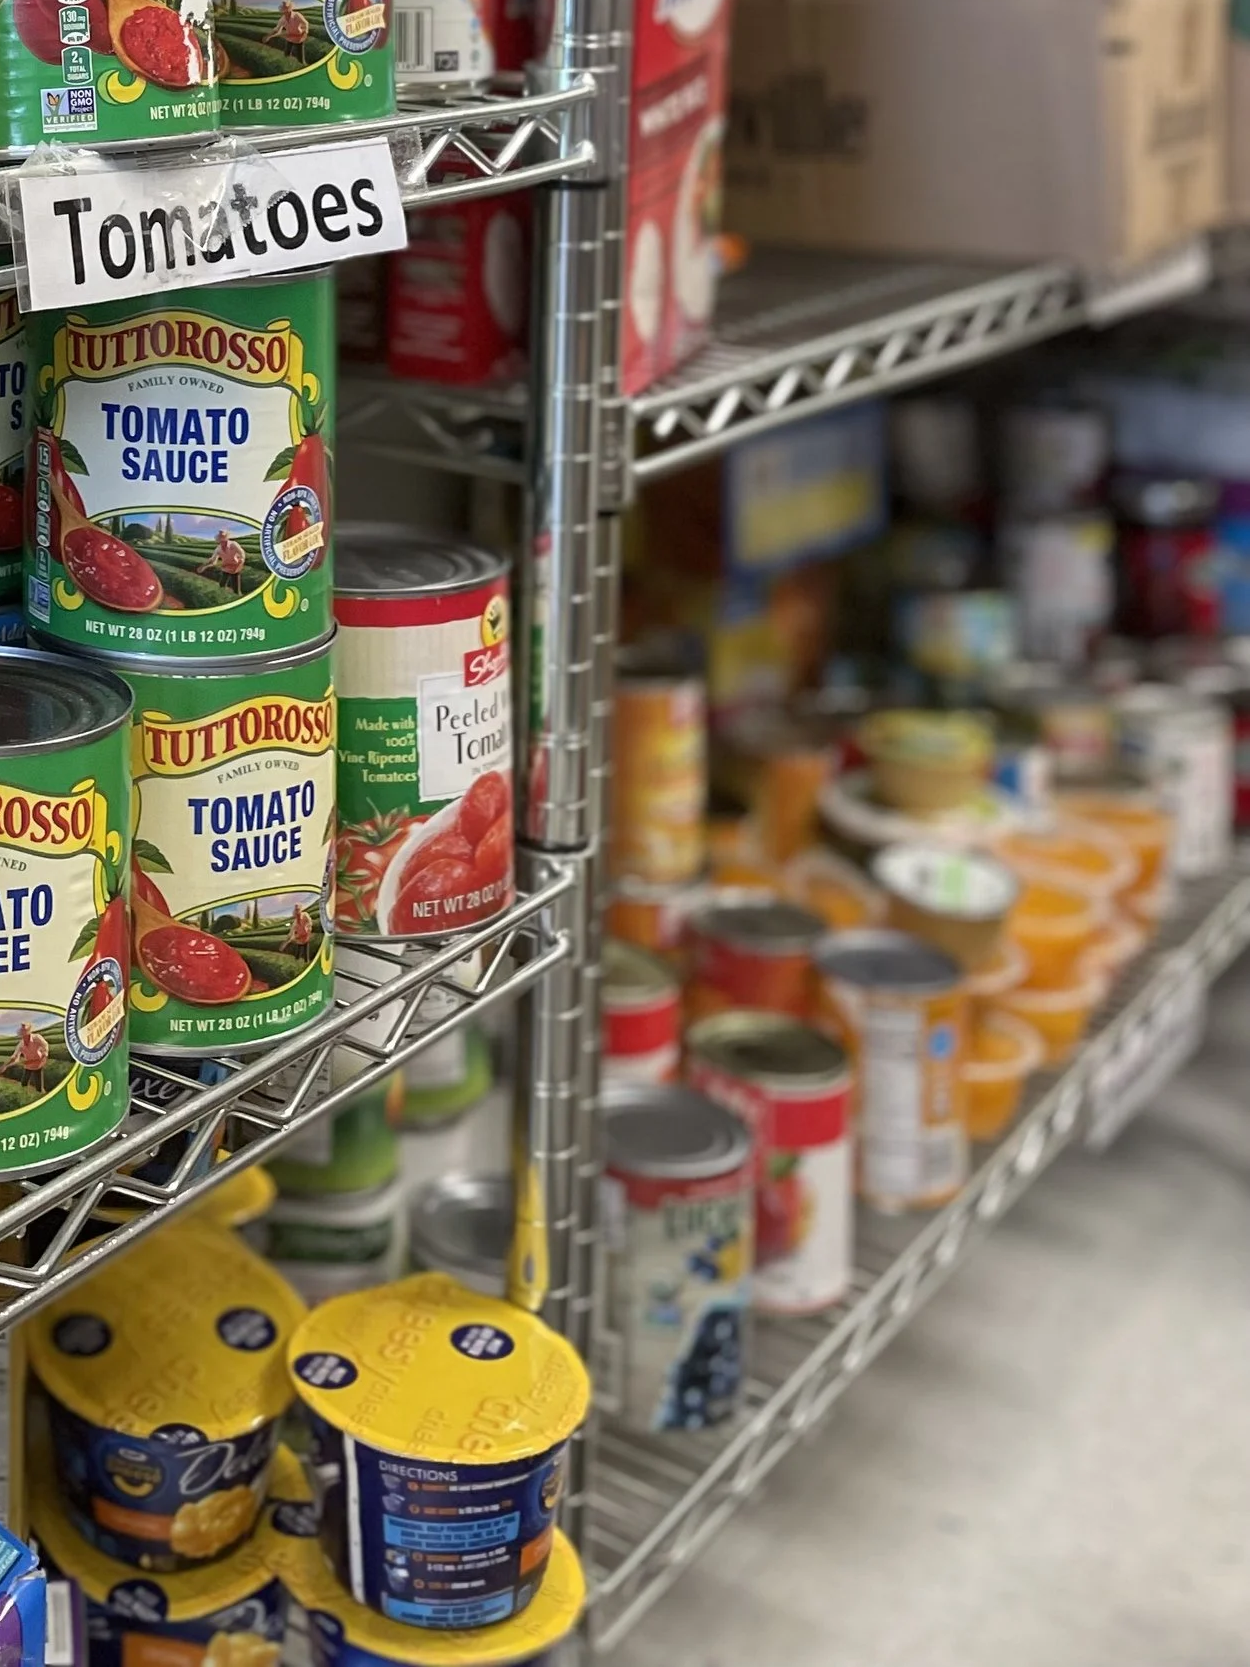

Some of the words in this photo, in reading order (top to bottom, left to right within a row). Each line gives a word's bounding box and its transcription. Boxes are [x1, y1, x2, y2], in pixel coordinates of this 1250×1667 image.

[70, 89, 92, 99] NON
[70, 98, 93, 107] GMO
[54, 175, 384, 286] Tomatoes
[68, 319, 287, 375] TUTTOROSSO
[127, 376, 174, 393] FAMILY
[179, 375, 224, 395] OWNED
[101, 402, 250, 446] TOMATO
[122, 448, 229, 484] SAUCE
[85, 620, 105, 637] NET
[108, 623, 126, 638] WT
[128, 626, 143, 640] 28
[146, 627, 162, 641] OZ
[165, 628, 176, 644] (1
[180, 630, 196, 643] LB
[199, 630, 214, 643] 12
[217, 628, 237, 644] OZ)
[240, 627, 266, 642] 794g
[355, 717, 389, 732] Made
[392, 715, 415, 731] with
[436, 692, 498, 732] Peeled
[145, 700, 332, 768] TUTTOROSSO
[338, 750, 365, 764] Vine
[368, 750, 416, 768] Ripened
[188, 779, 315, 835] TOMATO
[211, 825, 302, 873] SAUCE
[413, 900, 440, 919] NET
[444, 894, 465, 914] WT
[467, 891, 481, 910] 28
[483, 885, 495, 904] OZ
[378, 1459, 459, 1482] DIRECTIONS
